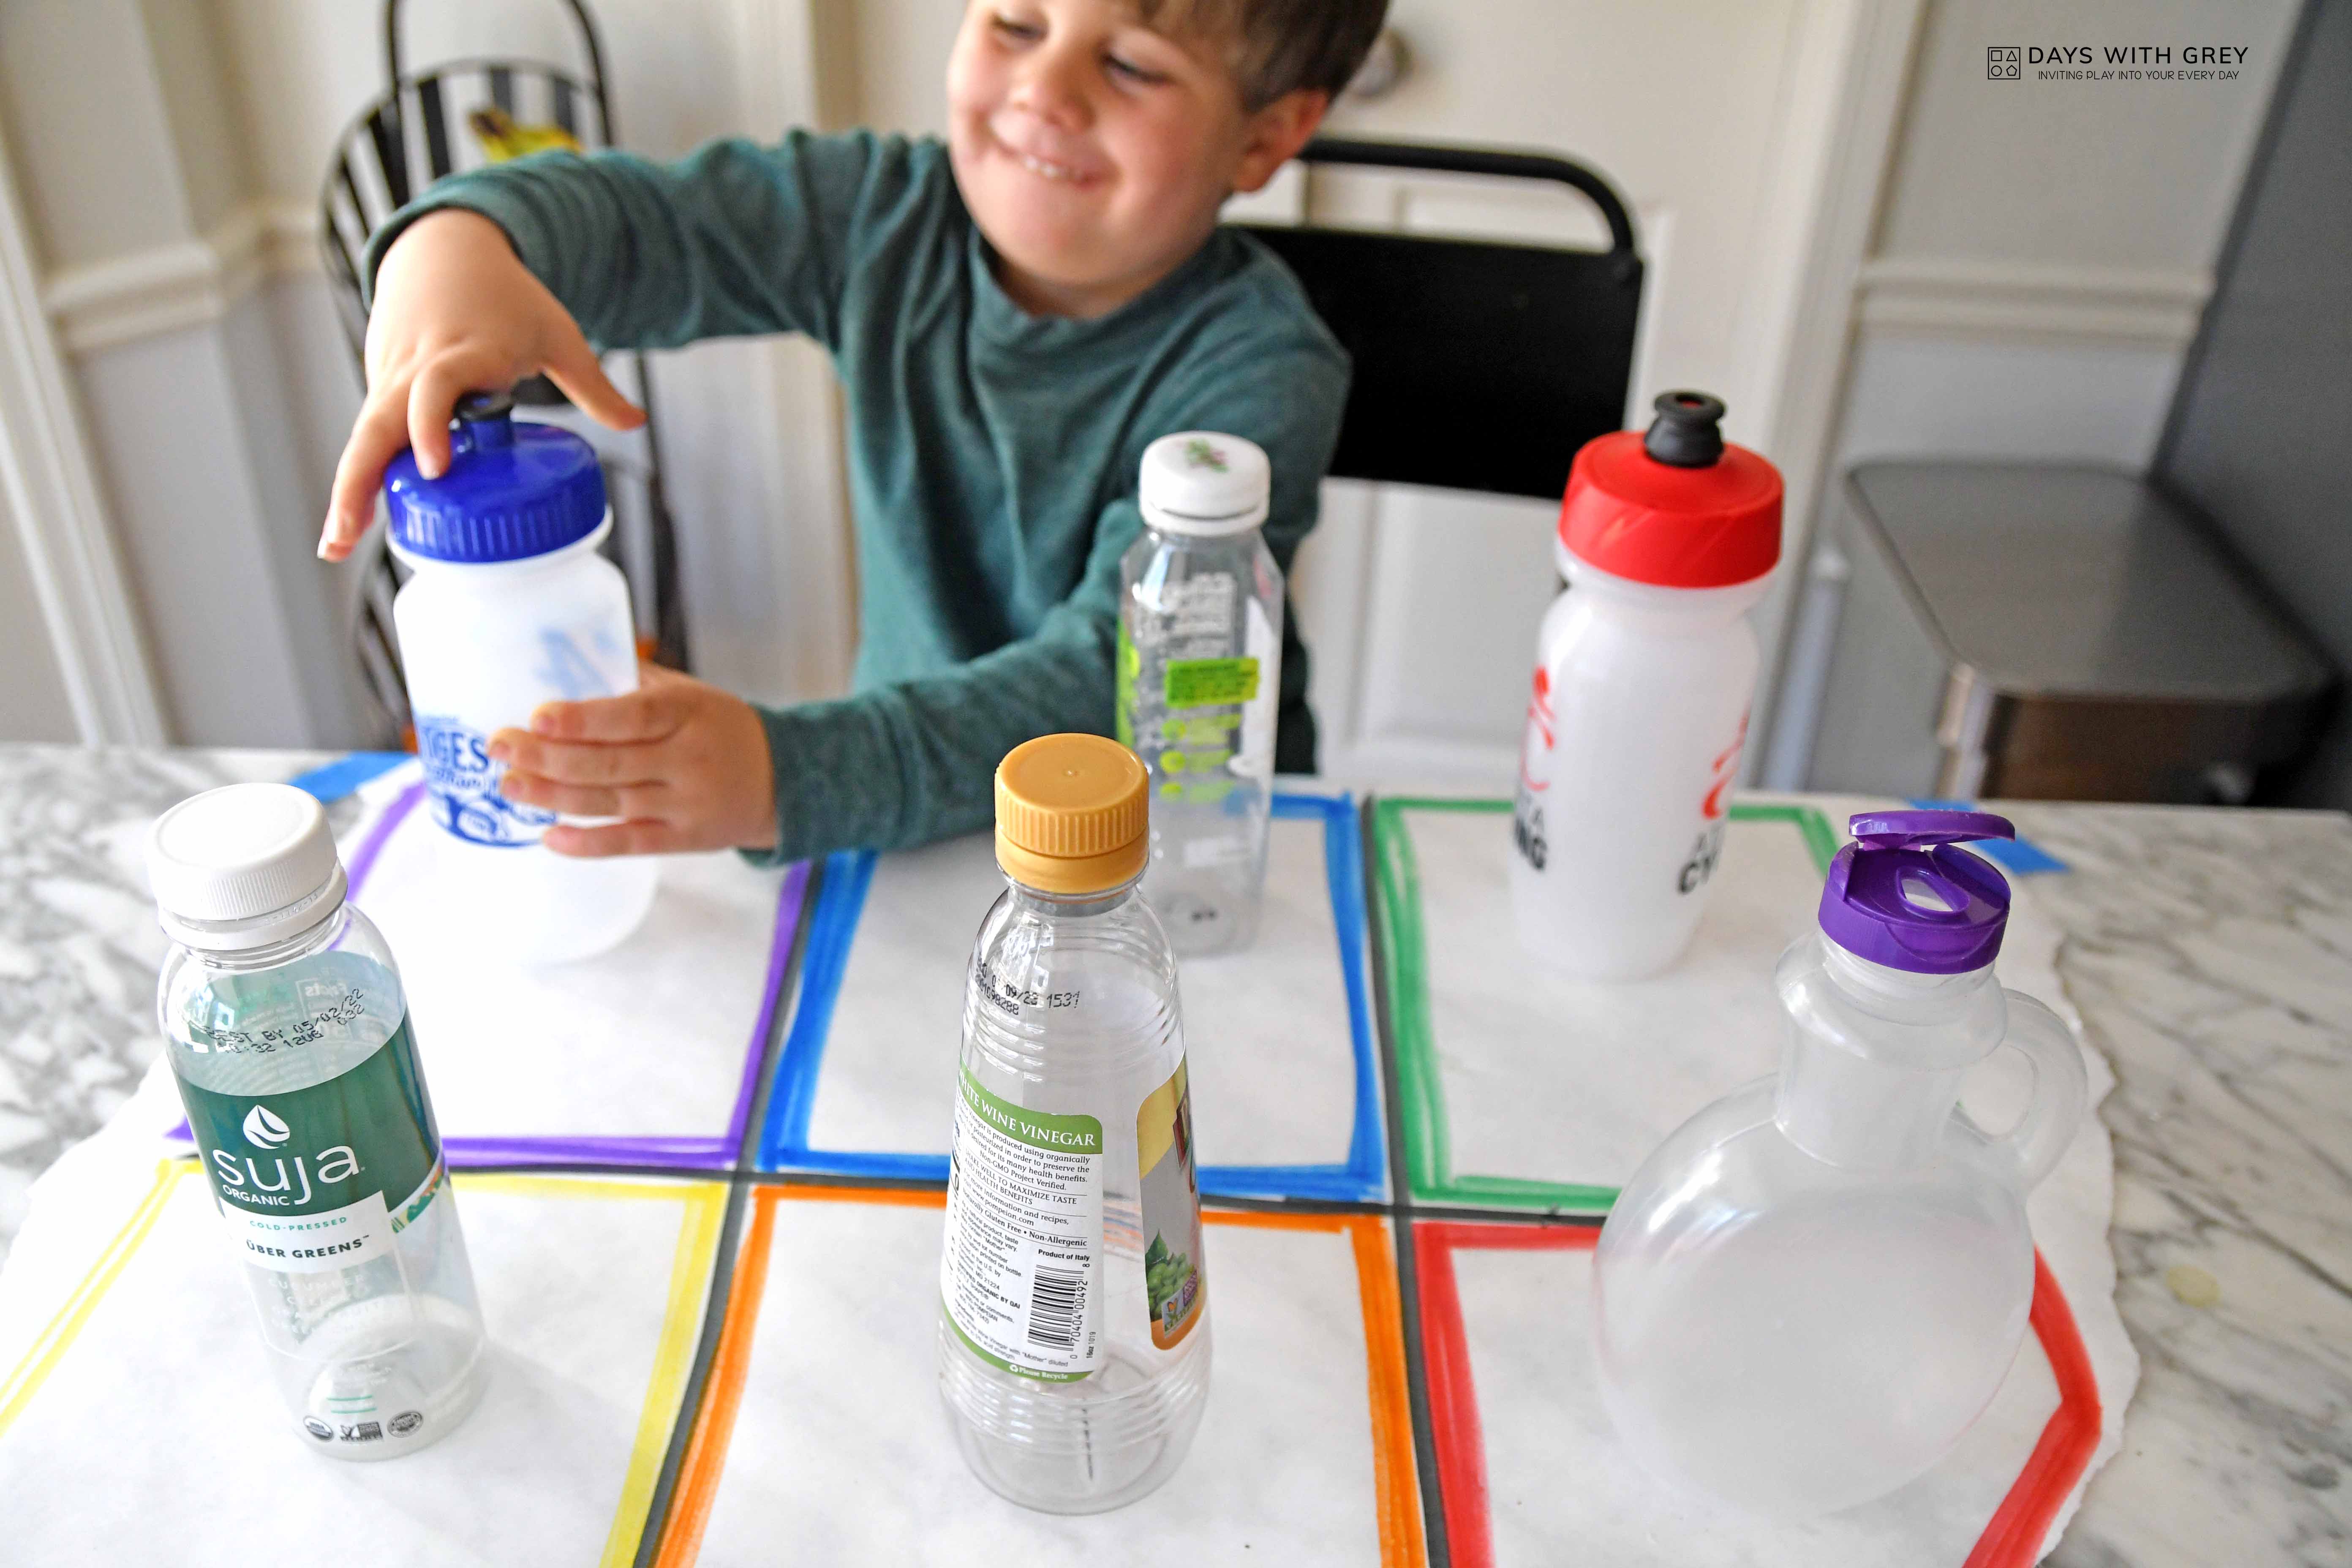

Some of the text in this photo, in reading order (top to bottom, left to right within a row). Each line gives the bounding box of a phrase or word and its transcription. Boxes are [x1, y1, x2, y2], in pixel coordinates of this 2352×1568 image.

[261, 1029, 284, 1041] BY
[293, 988, 364, 1034] 05/02/22
[969, 1109, 985, 1130] Vinegar
[987, 1127, 991, 1135] is
[993, 1132, 1022, 1151] produced
[1024, 1147, 1044, 1160] using
[1046, 1153, 1090, 1165] organically
[981, 1099, 1016, 1131] WINE
[1020, 1122, 1095, 1146] VINEGAR
[971, 1132, 987, 1151] desired
[1007, 1160, 1027, 1172] many
[1029, 1167, 1053, 1179] health
[1056, 1173, 1088, 1182] benefits.
[974, 1126, 1003, 1152] pasteurized
[1005, 1148, 1011, 1156] in
[1013, 1154, 1032, 1164] order
[1043, 1162, 1075, 1172] preserve
[212, 1145, 359, 1205] suja
[976, 1169, 998, 1190] HEALTH
[1000, 1186, 1033, 1205] BENEFITS
[980, 1150, 1067, 1190] Non-GMO Project Verified.
[981, 1164, 996, 1180] WELL
[998, 1176, 1008, 1186] TO
[1010, 1183, 1050, 1200] MAXIMIZE
[1052, 1195, 1077, 1204] TASTE
[223, 1184, 290, 1206] ORGANIC
[971, 1177, 983, 1192] more
[984, 1188, 1022, 1214] information
[1024, 1211, 1039, 1219] and
[1041, 1215, 1069, 1225] recipes,
[972, 1187, 1034, 1226] www.pompeian.com
[250, 1217, 347, 1231] COLD-PRESSED
[985, 1210, 1005, 1227] Gluten
[1007, 1222, 1021, 1234] Free
[1029, 1230, 1087, 1247] Non-Allergenic
[1005, 1235, 1018, 1245] taste
[246, 1239, 286, 1258] ÜBER
[1005, 1243, 1018, 1252] vary.
[1038, 1249, 1064, 1259] Product
[1074, 1280, 1088, 1310] 00492
[1070, 1314, 1083, 1342] 70404
